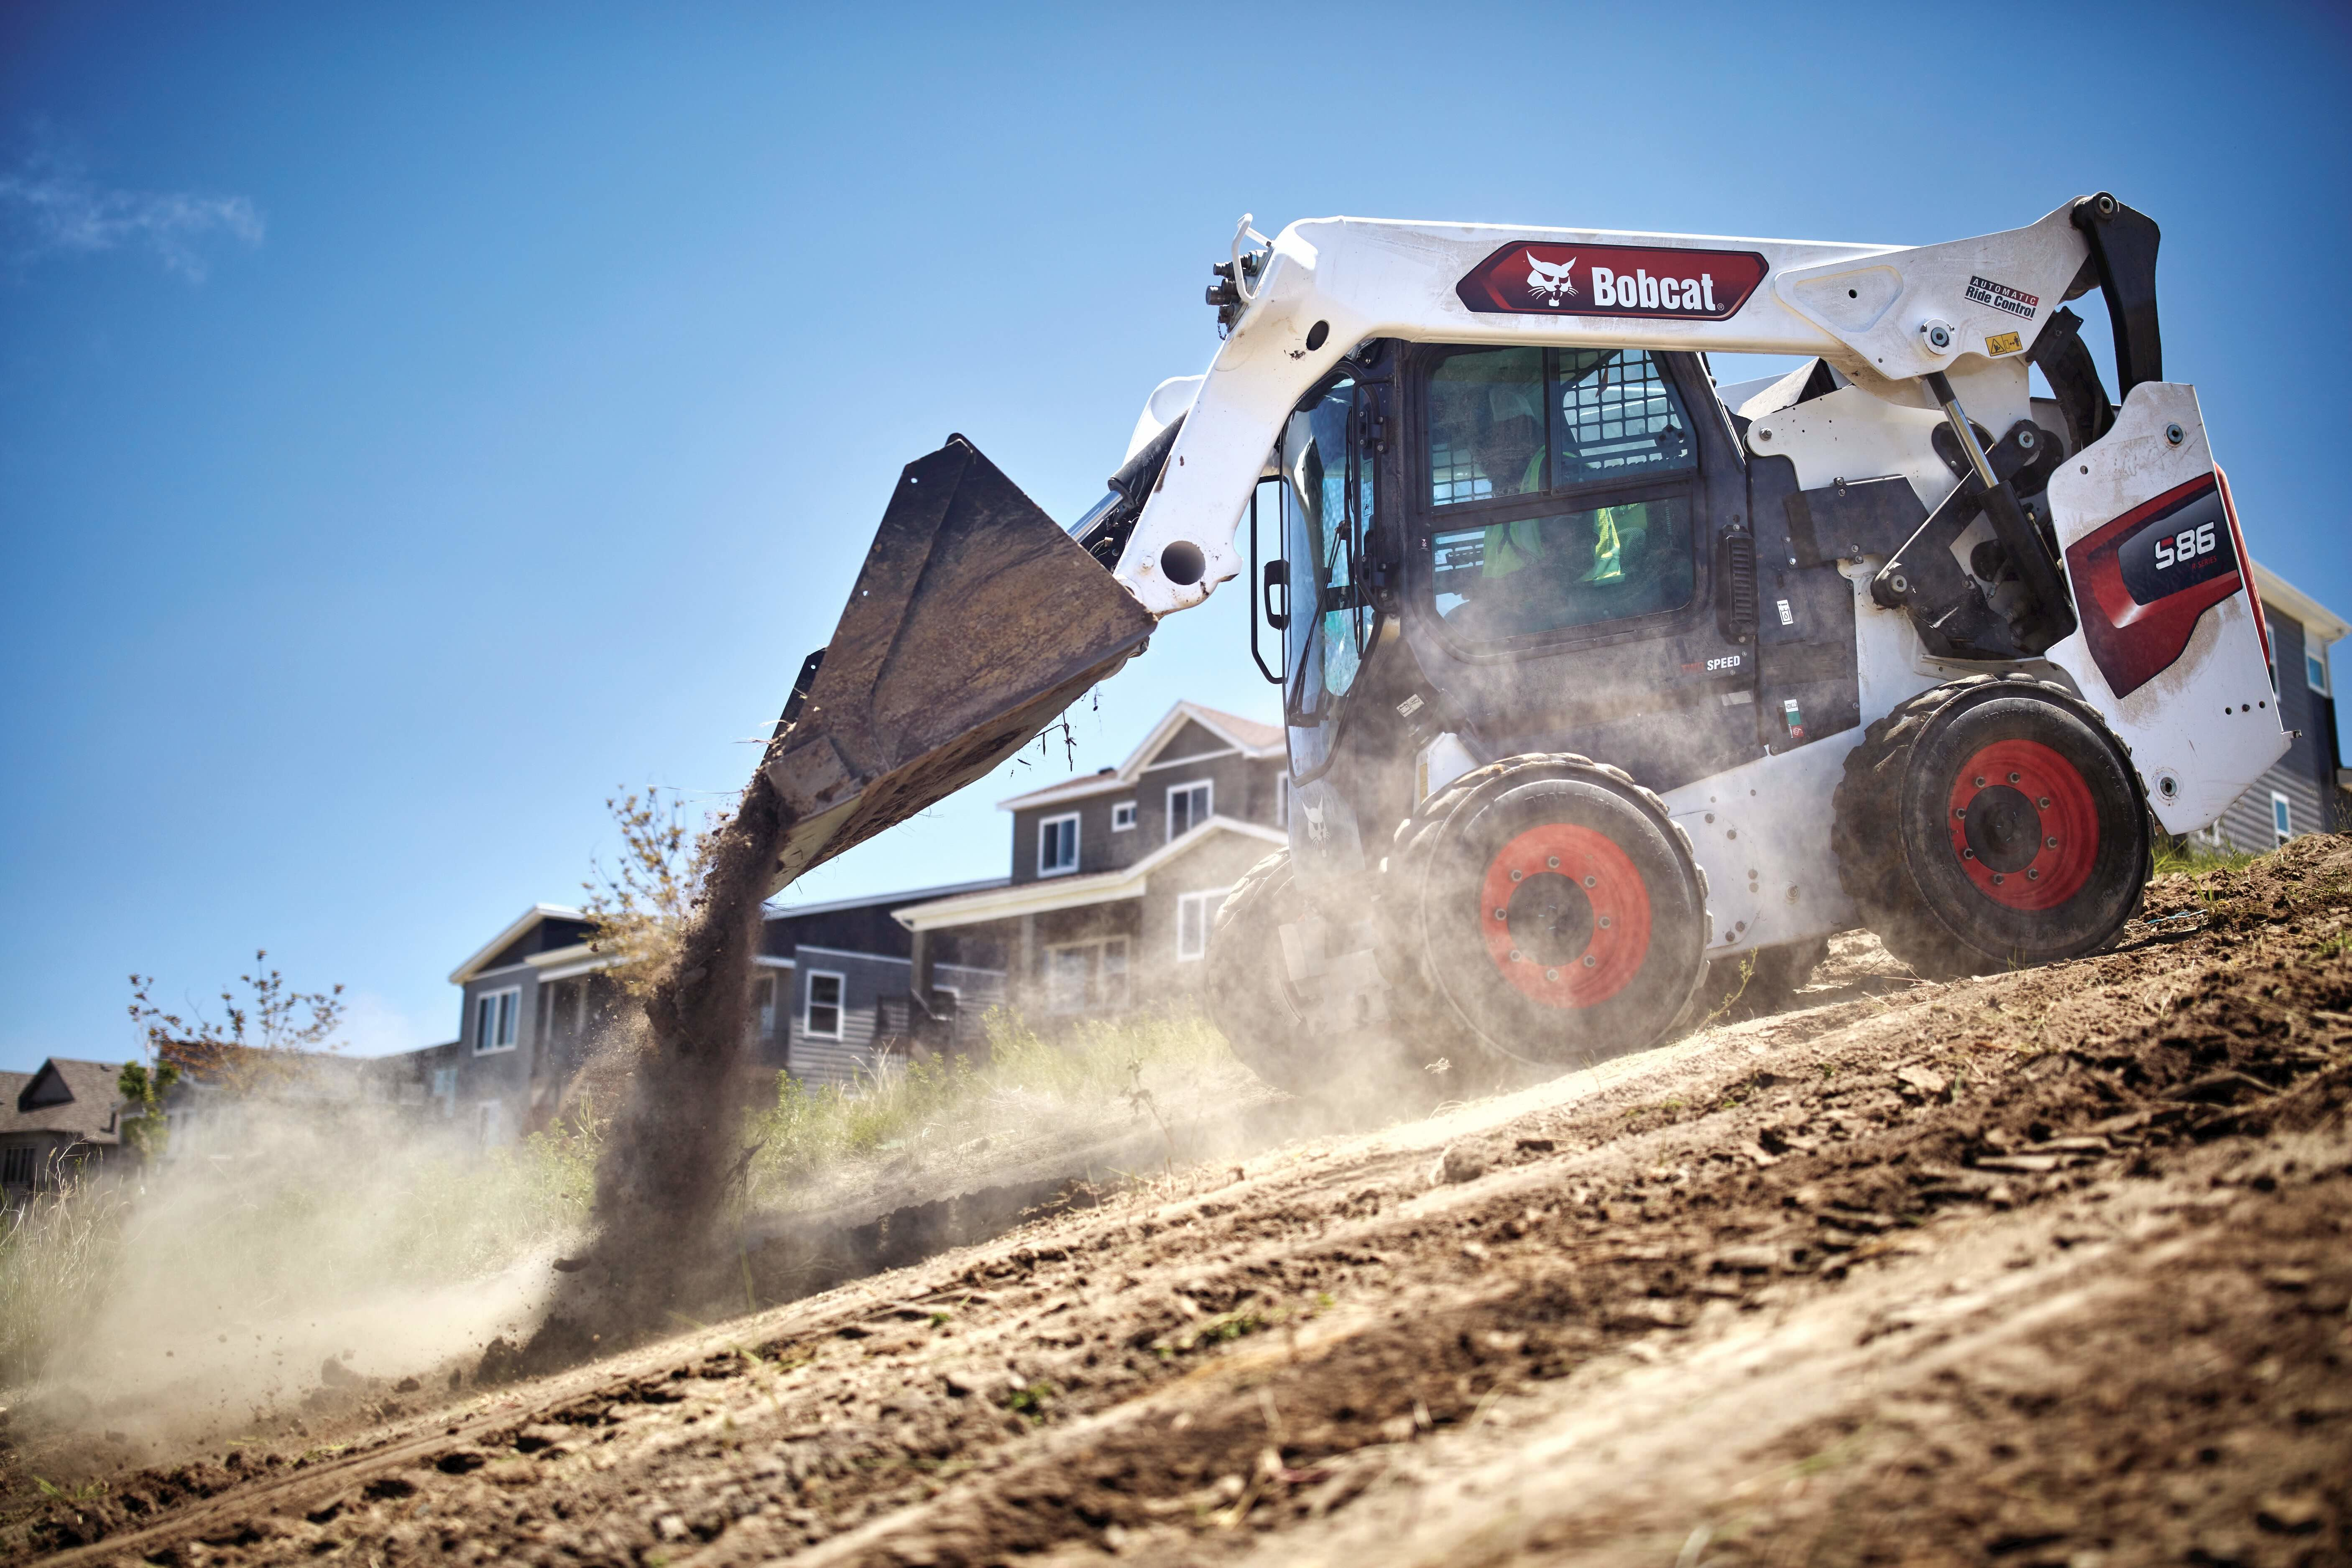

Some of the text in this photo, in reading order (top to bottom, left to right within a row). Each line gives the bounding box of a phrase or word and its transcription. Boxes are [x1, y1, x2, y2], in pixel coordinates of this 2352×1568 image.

[1591, 266, 1716, 311] Bobcat
[1965, 286, 2036, 318] Ride Control
[1972, 278, 2036, 305] AUTOMATIC
[2155, 521, 2216, 570] S86
[1707, 655, 1740, 671] SPEED
